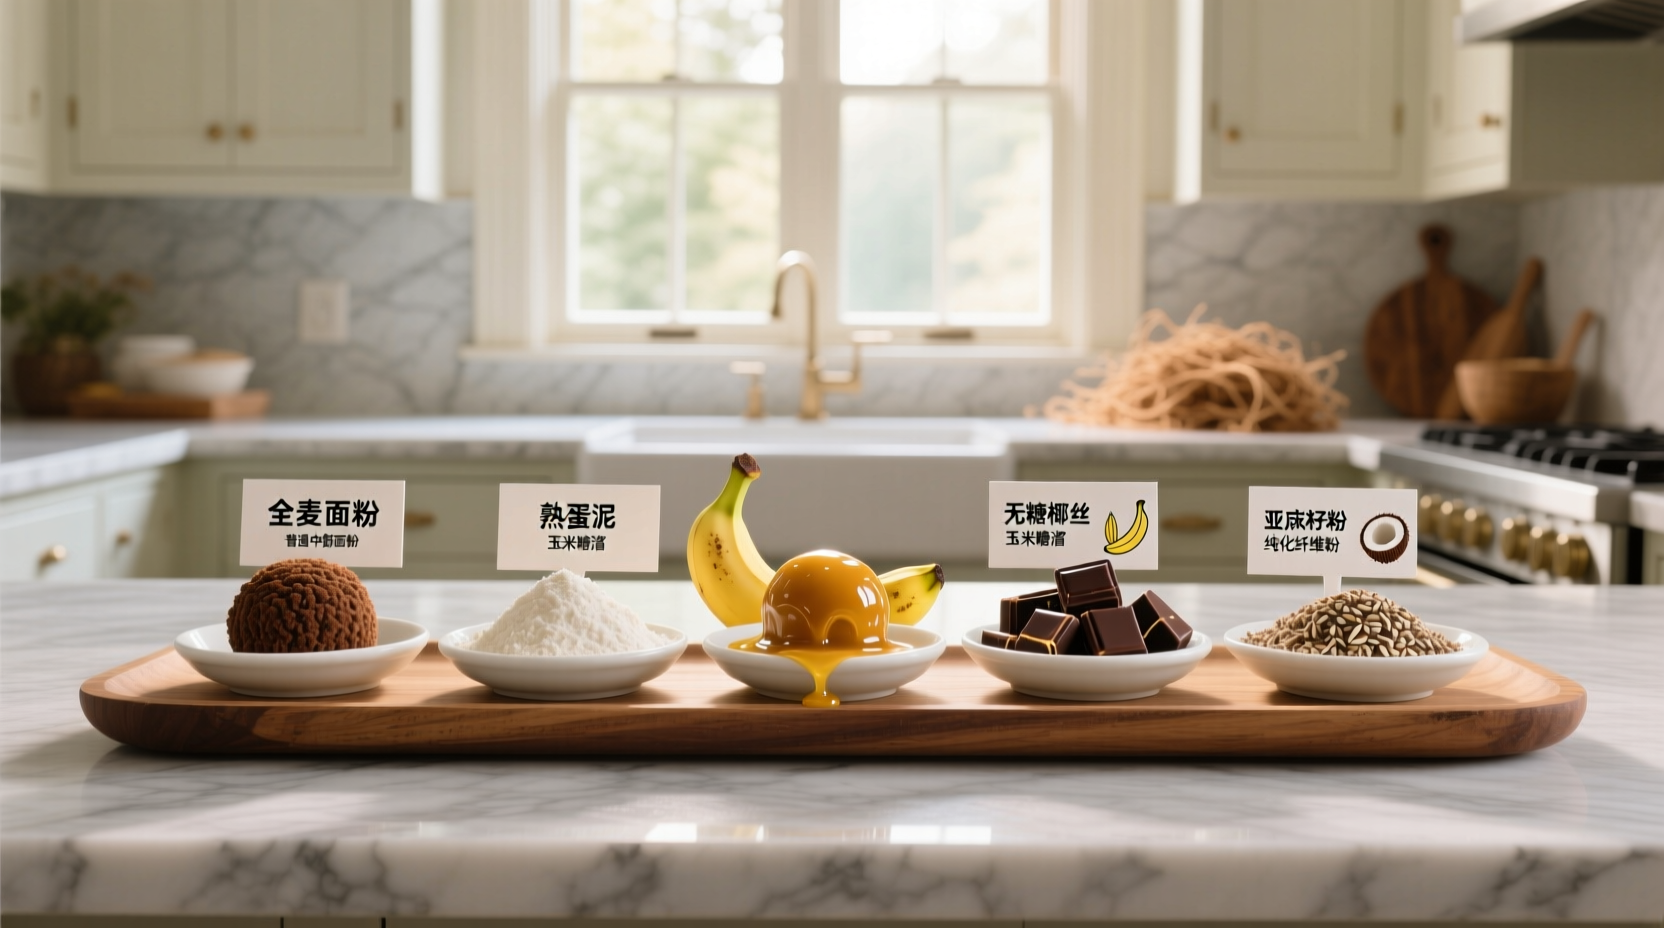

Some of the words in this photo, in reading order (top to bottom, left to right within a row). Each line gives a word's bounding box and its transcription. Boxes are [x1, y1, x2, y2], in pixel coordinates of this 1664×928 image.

[268, 498, 380, 528] 全麦面粉
[540, 501, 616, 530] 熟蛋泥
[1004, 500, 1090, 526] 无糖椰丝
